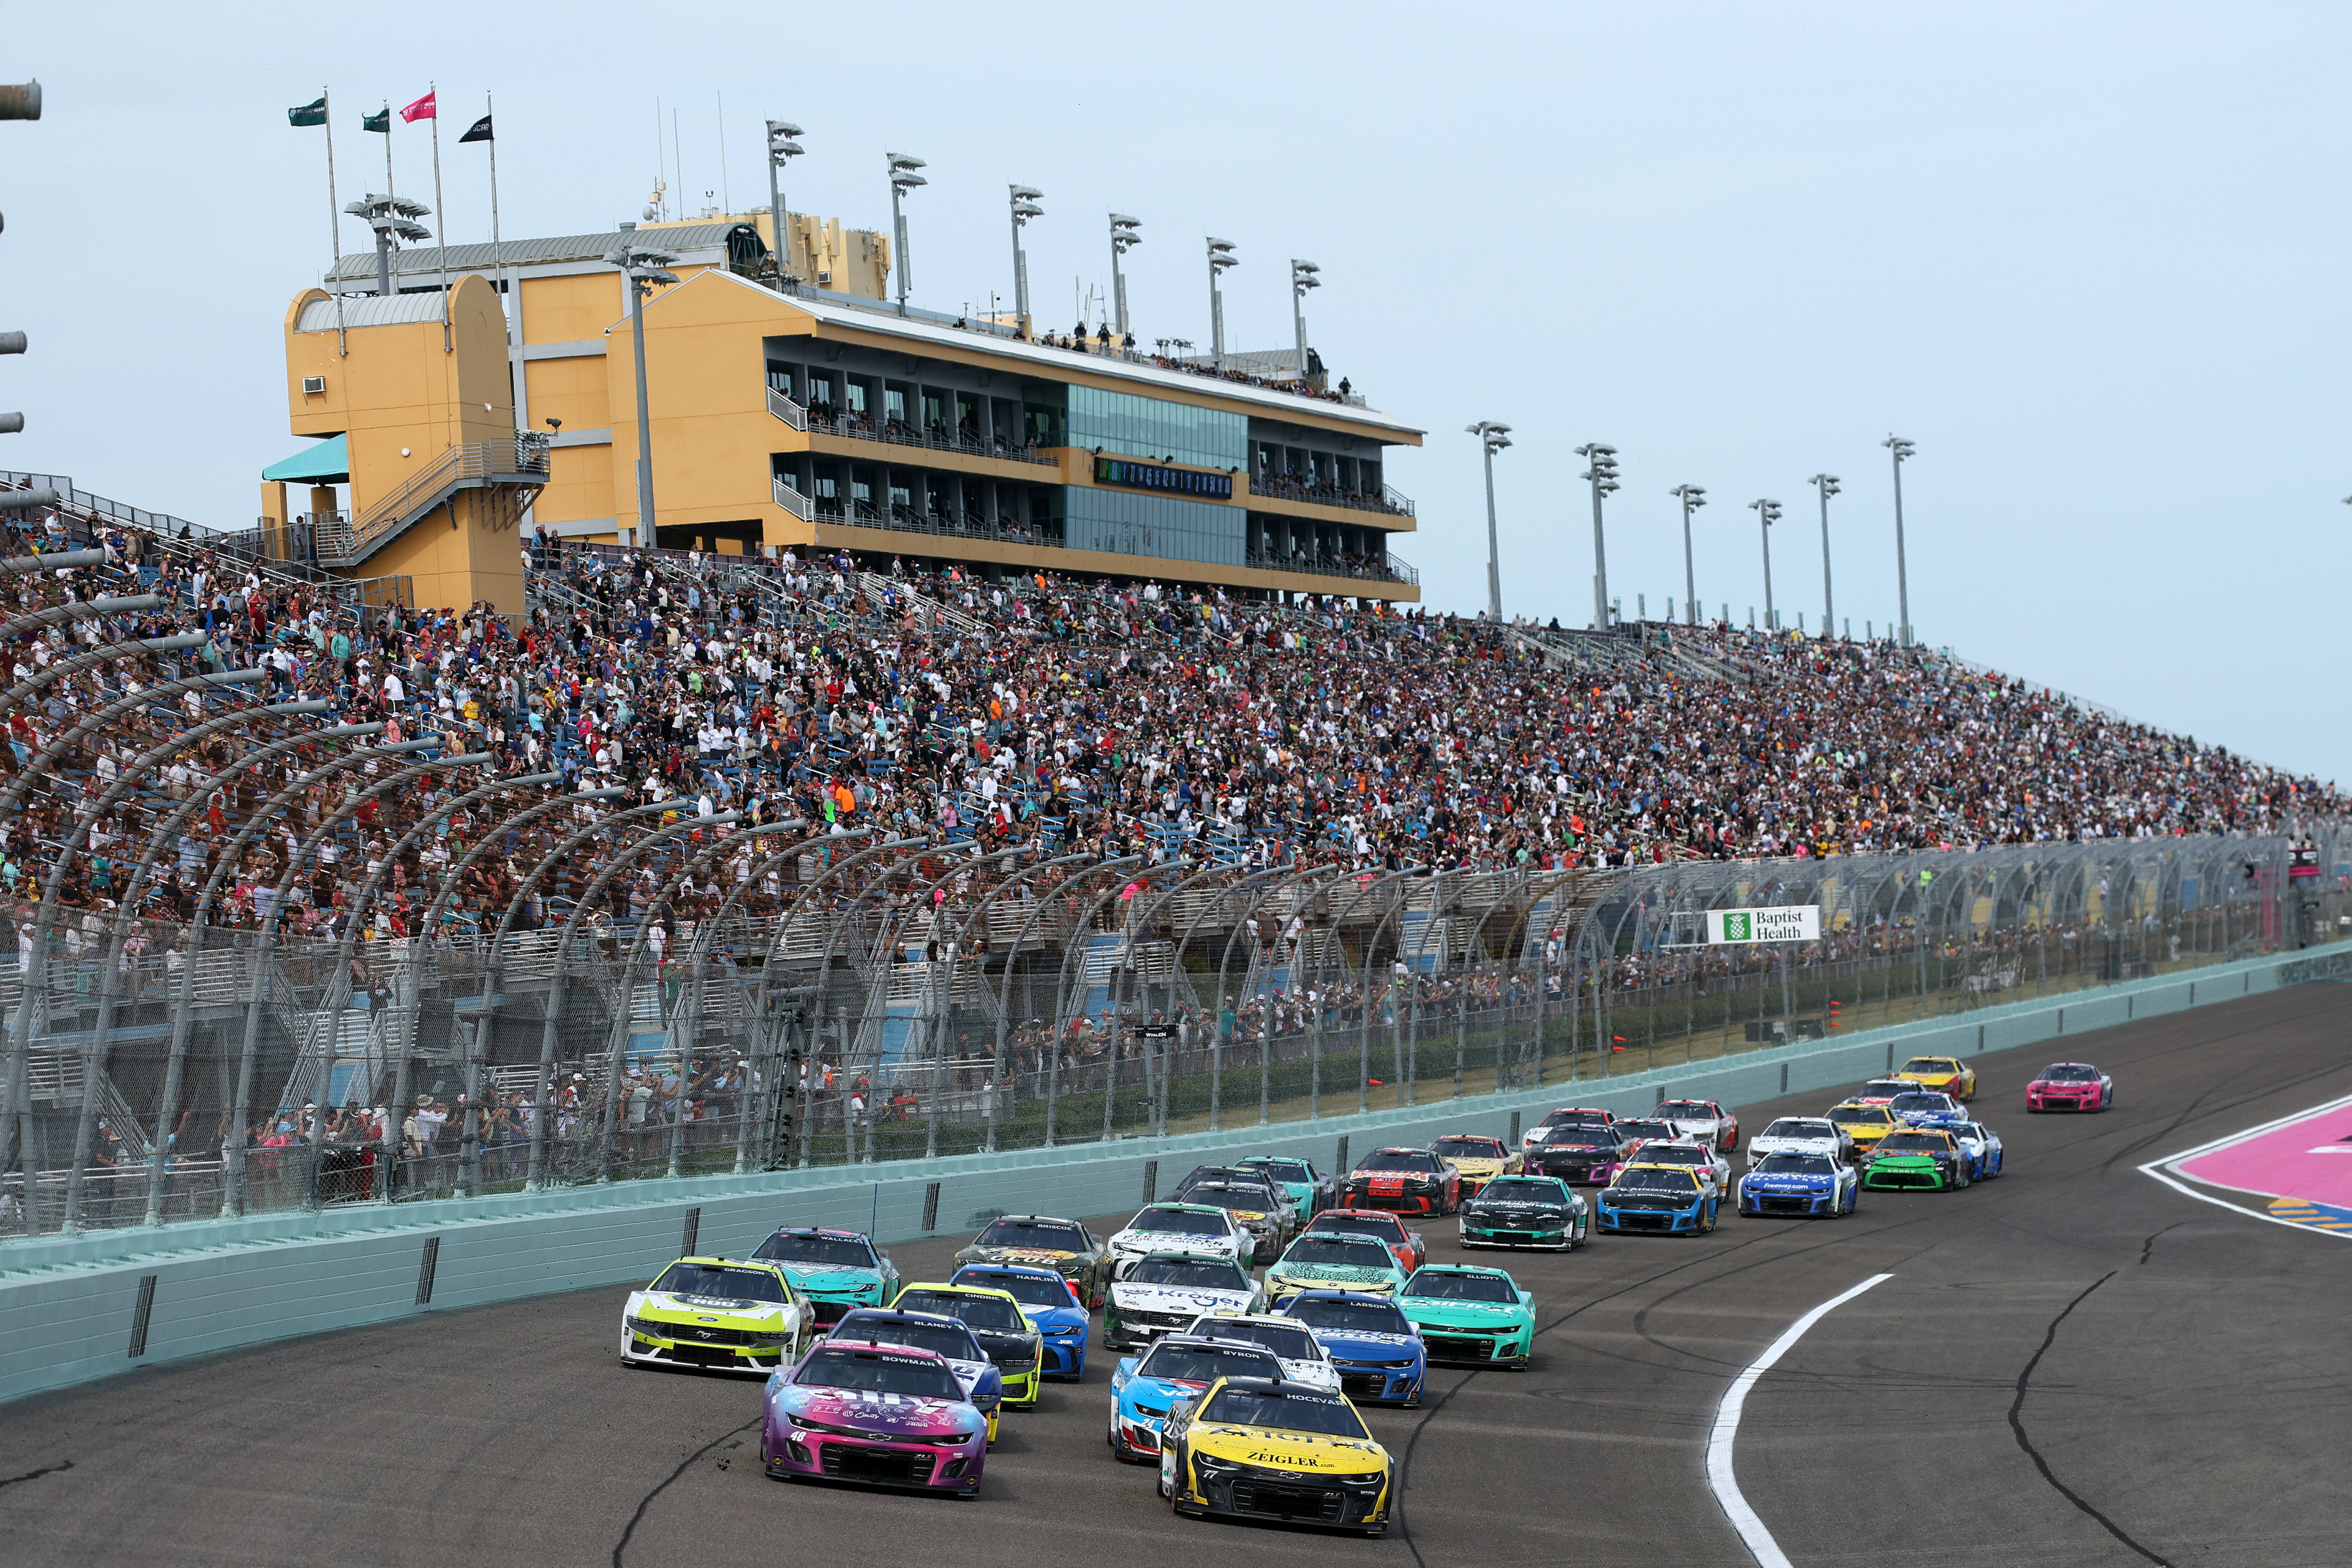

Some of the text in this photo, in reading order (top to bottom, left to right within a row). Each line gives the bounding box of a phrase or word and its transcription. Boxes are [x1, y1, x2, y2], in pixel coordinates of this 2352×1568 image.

[1757, 911, 1803, 925] Baptist
[1757, 926, 1801, 940] Health
[990, 1255, 1058, 1265] CLUB
[724, 1267, 765, 1276] GRAGSON
[1017, 1274, 1054, 1283] HAMLIN
[1158, 1289, 1243, 1308] Kroger
[914, 1321, 952, 1329] BLANEY
[1223, 1351, 1260, 1359] BYRON
[882, 1356, 935, 1367] BOWMAN
[1287, 1393, 1343, 1406] HOCEVAR
[1139, 1419, 1156, 1429] 24
[790, 1431, 807, 1442] 48
[1203, 1470, 1219, 1479] 77
